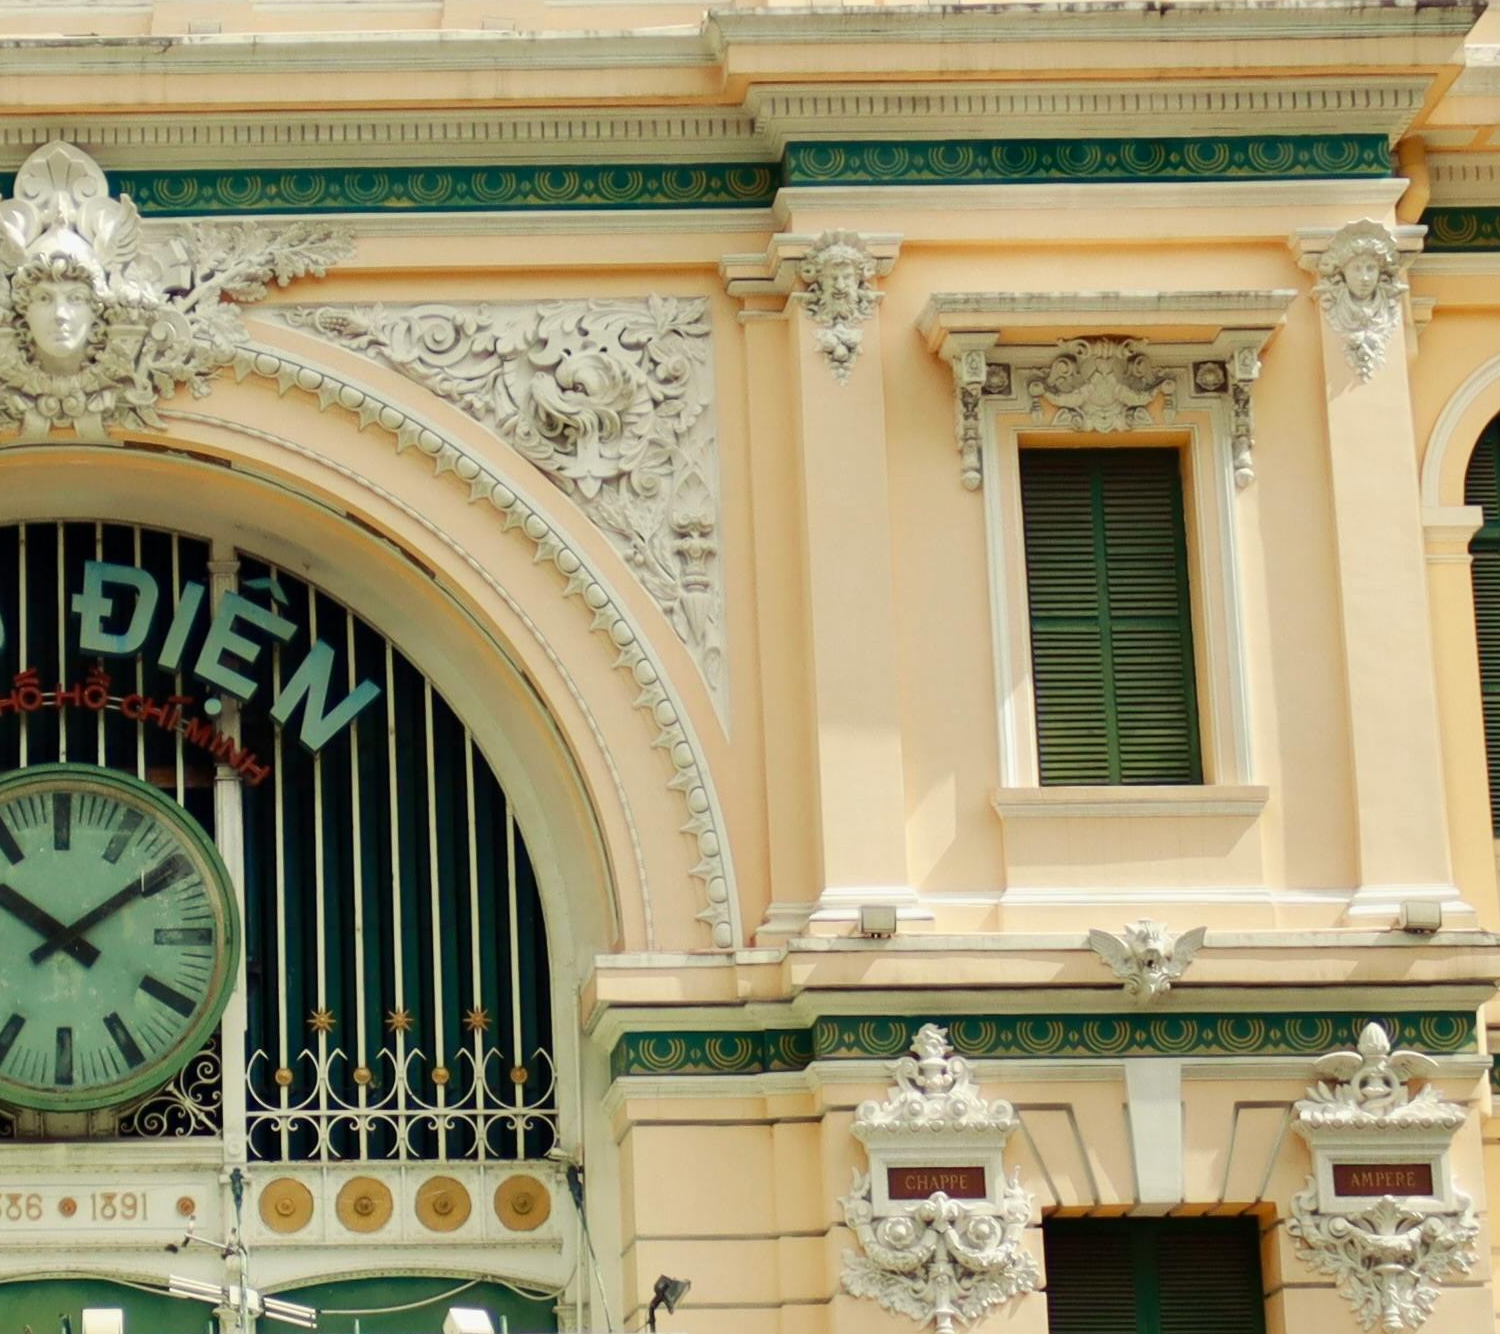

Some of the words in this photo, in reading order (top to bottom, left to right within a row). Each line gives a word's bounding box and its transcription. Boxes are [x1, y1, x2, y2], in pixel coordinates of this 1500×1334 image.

[71, 559, 382, 754] ĐIỆN
[184, 717, 271, 786] MINH
[904, 1173, 968, 1190] CHAPPE
[1350, 1172, 1417, 1188] AMPERE
[90, 1191, 149, 1222] 1891
